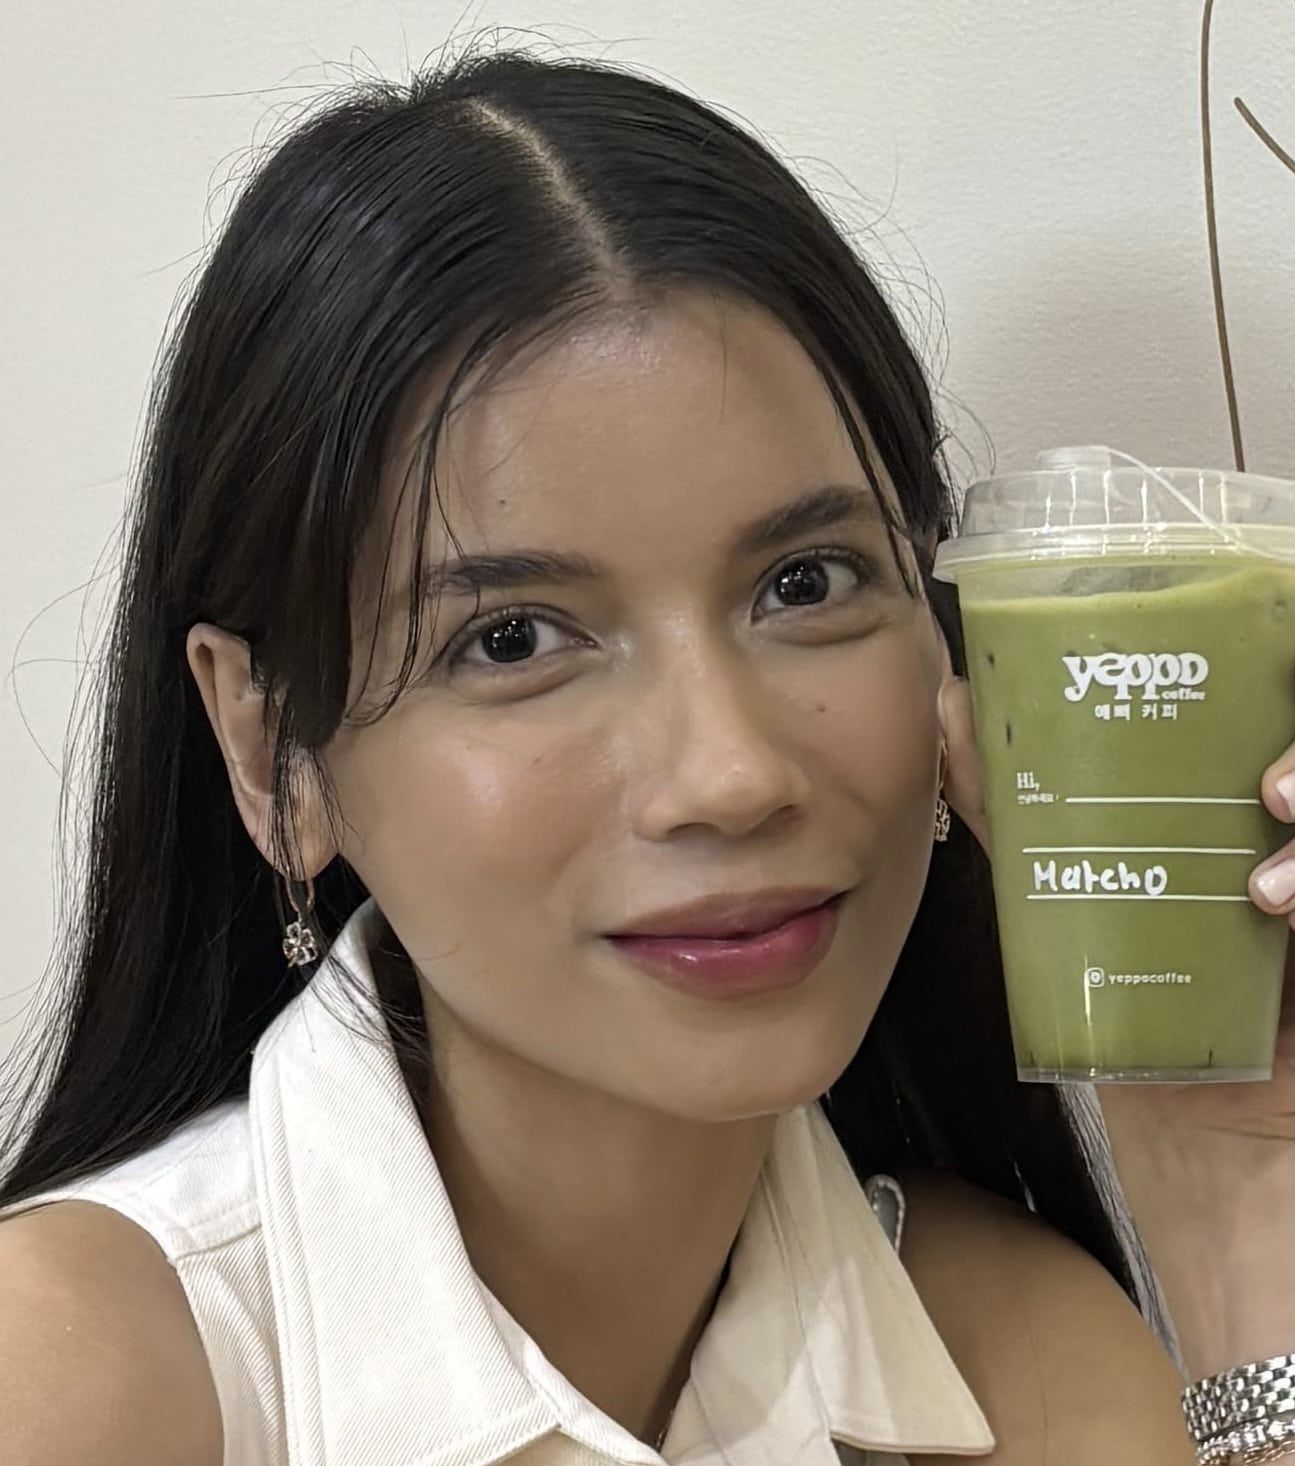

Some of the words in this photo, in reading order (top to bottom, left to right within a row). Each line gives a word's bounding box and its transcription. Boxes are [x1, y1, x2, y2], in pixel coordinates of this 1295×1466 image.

[1061, 652, 1209, 701] yeppo
[1161, 687, 1206, 700] coffee
[1108, 971, 1192, 985] yeppocoffee
